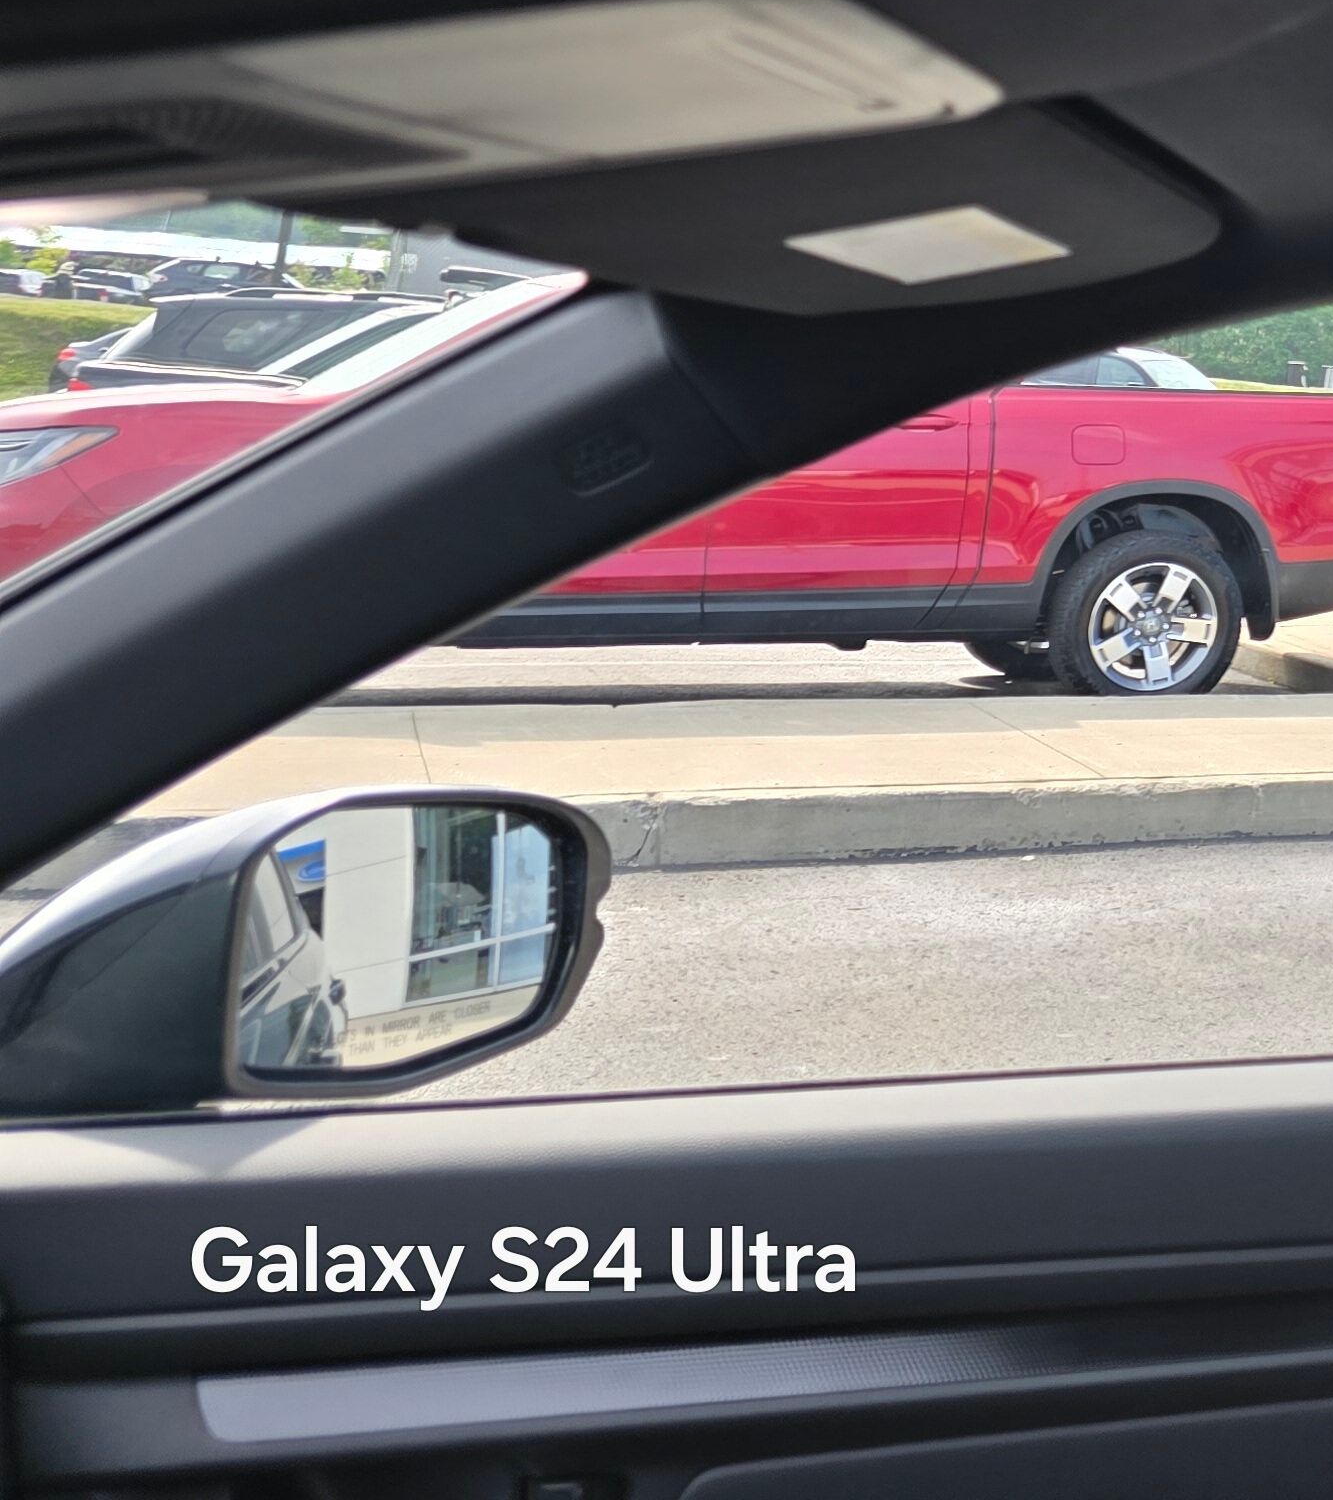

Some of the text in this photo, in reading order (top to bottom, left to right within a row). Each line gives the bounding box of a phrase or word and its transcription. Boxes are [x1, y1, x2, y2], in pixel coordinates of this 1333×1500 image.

[382, 1015, 421, 1033] MIRROR
[428, 1010, 447, 1025] ARE
[349, 1039, 376, 1056] THAN
[383, 1033, 409, 1049] THEY
[415, 1023, 454, 1043] APPEAR
